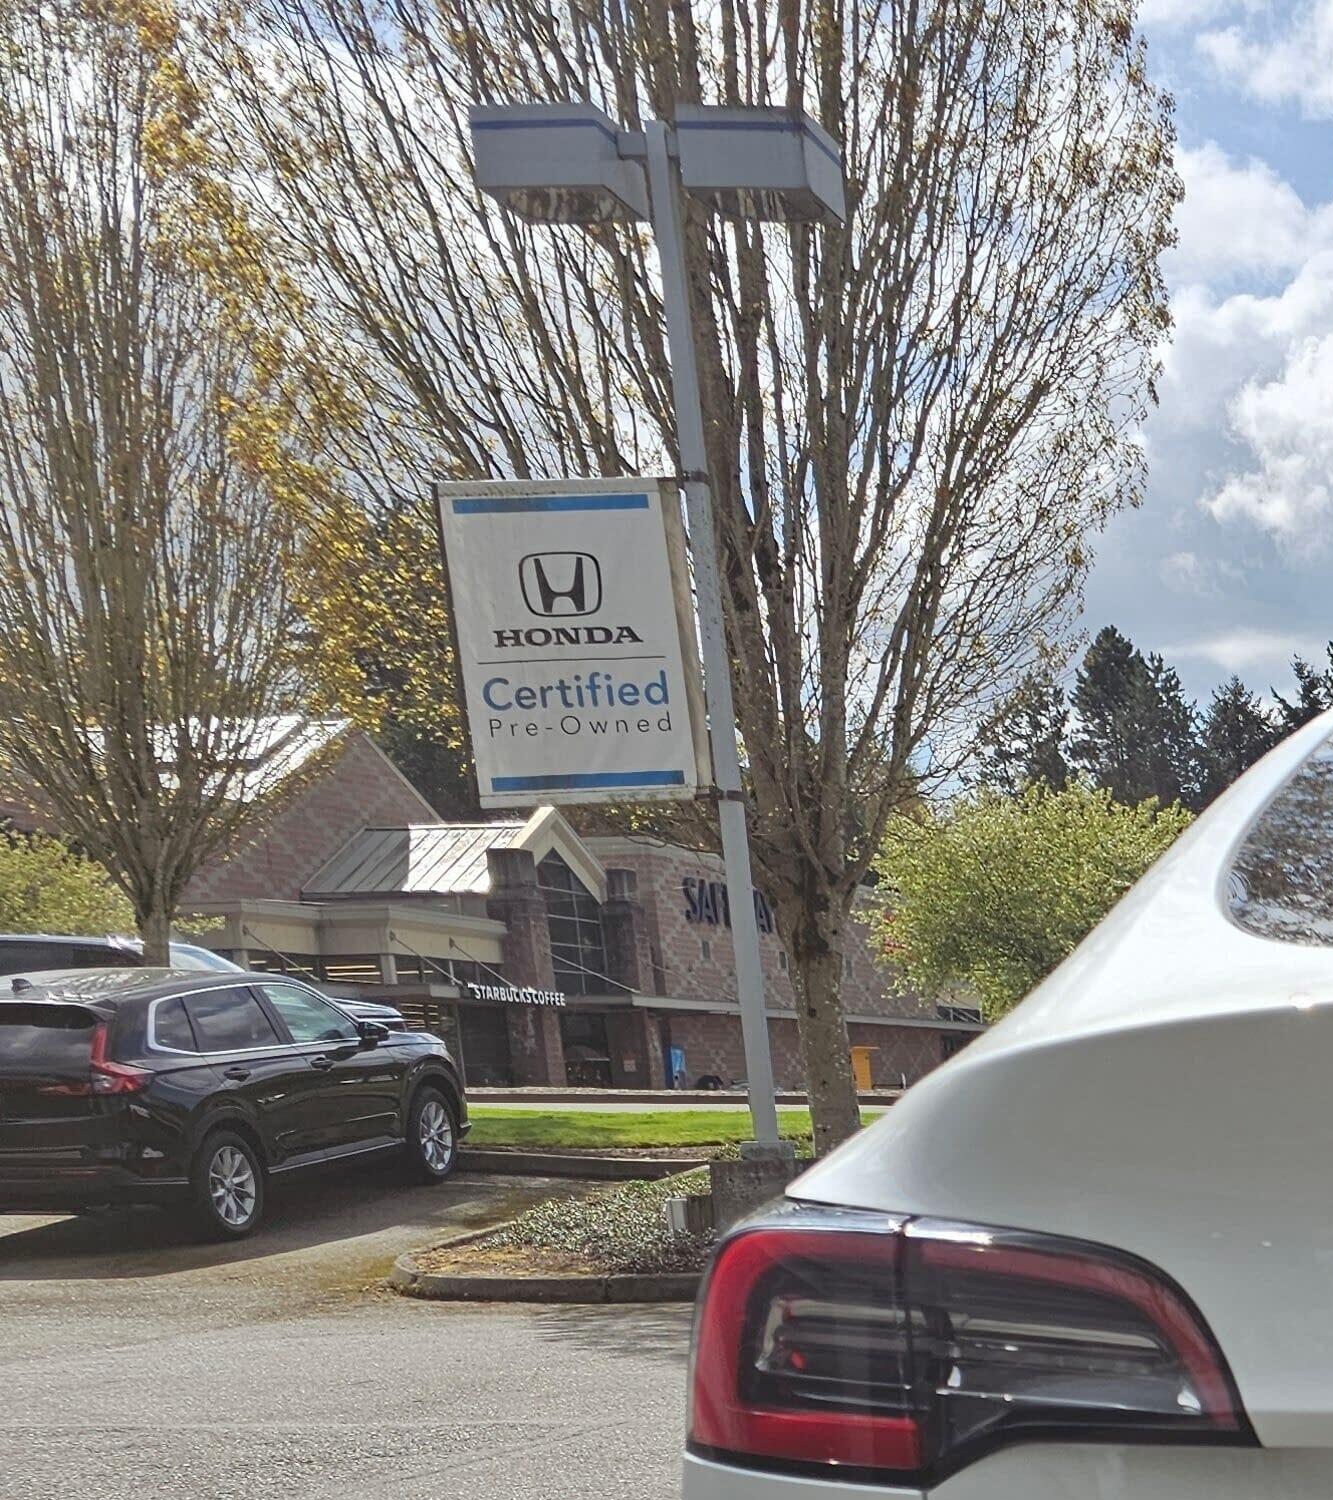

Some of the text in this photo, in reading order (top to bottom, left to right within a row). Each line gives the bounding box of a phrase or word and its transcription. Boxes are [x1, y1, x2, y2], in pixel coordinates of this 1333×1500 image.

[493, 626, 644, 648] HONDA
[483, 670, 670, 712] Certified
[489, 711, 673, 738] Pre-Owned
[474, 984, 566, 1007] STARBUCKS COFFEE
